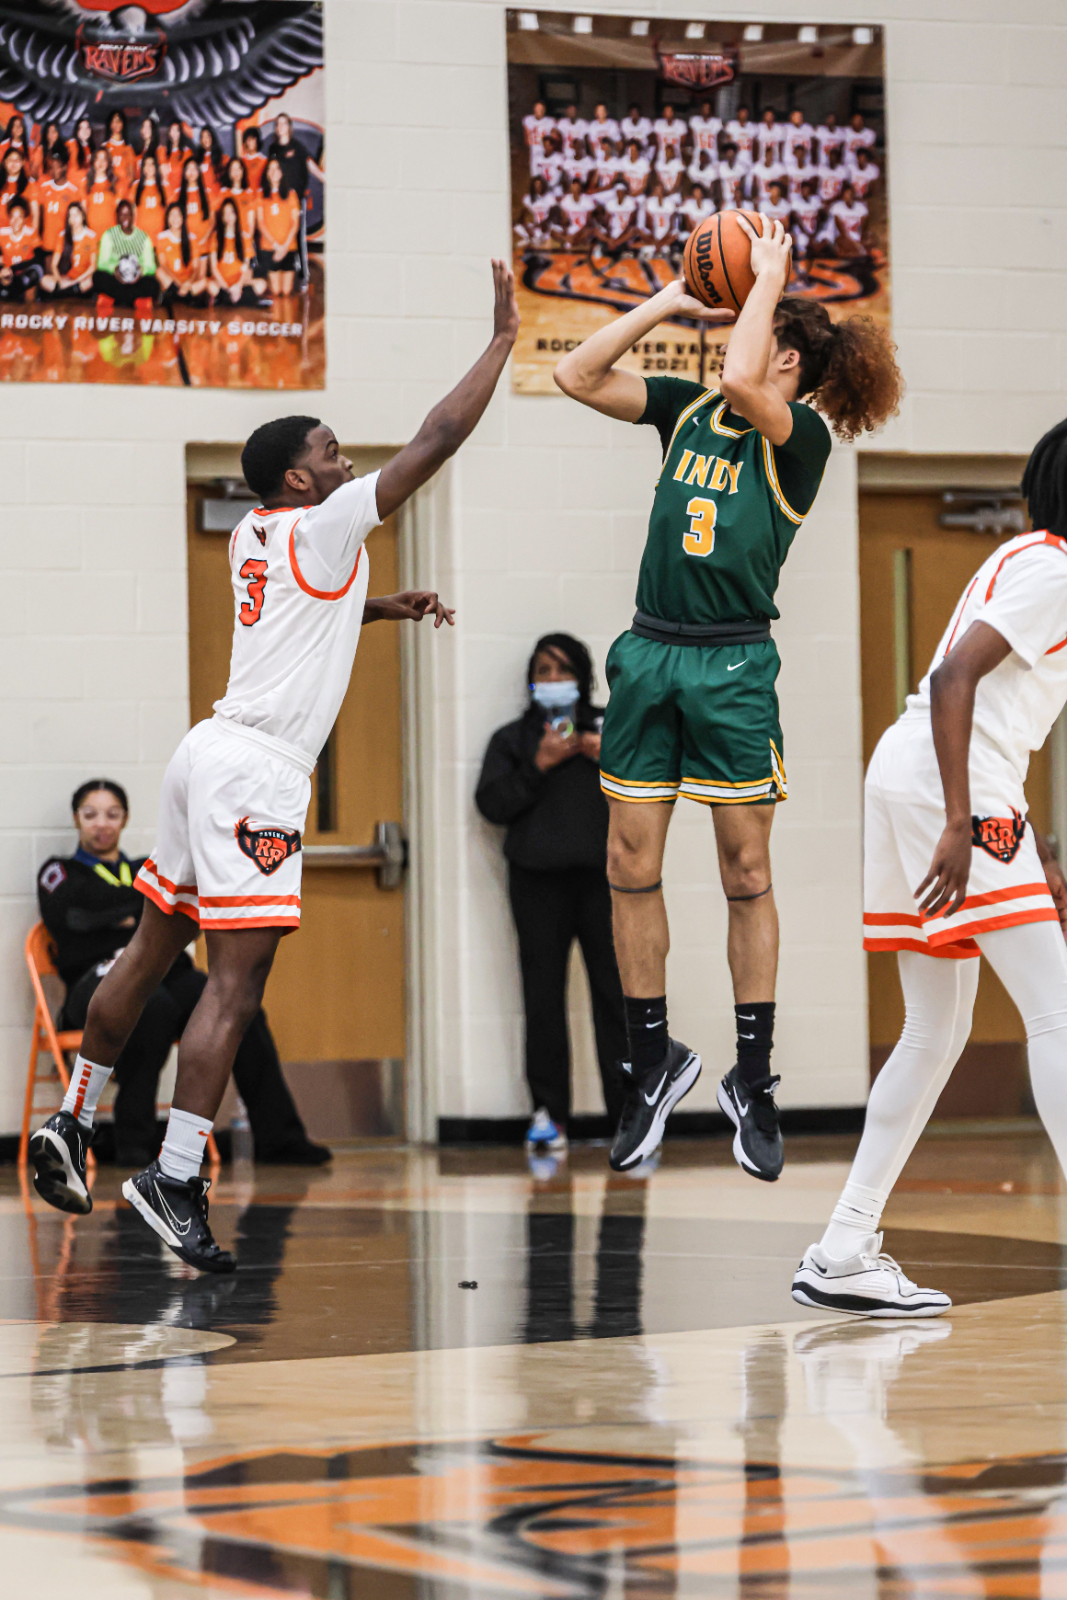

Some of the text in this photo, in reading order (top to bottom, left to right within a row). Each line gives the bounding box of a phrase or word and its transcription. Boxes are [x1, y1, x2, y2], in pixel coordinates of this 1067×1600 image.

[83, 46, 157, 76] RAVENS
[696, 230, 723, 304] Wilson
[1, 313, 303, 337] ROCKY RIVER VARSITY SOCCER
[537, 338, 584, 352] ROC
[631, 341, 667, 354] VER
[672, 448, 744, 495] INDY
[682, 496, 718, 557] 3
[238, 558, 268, 627] 3
